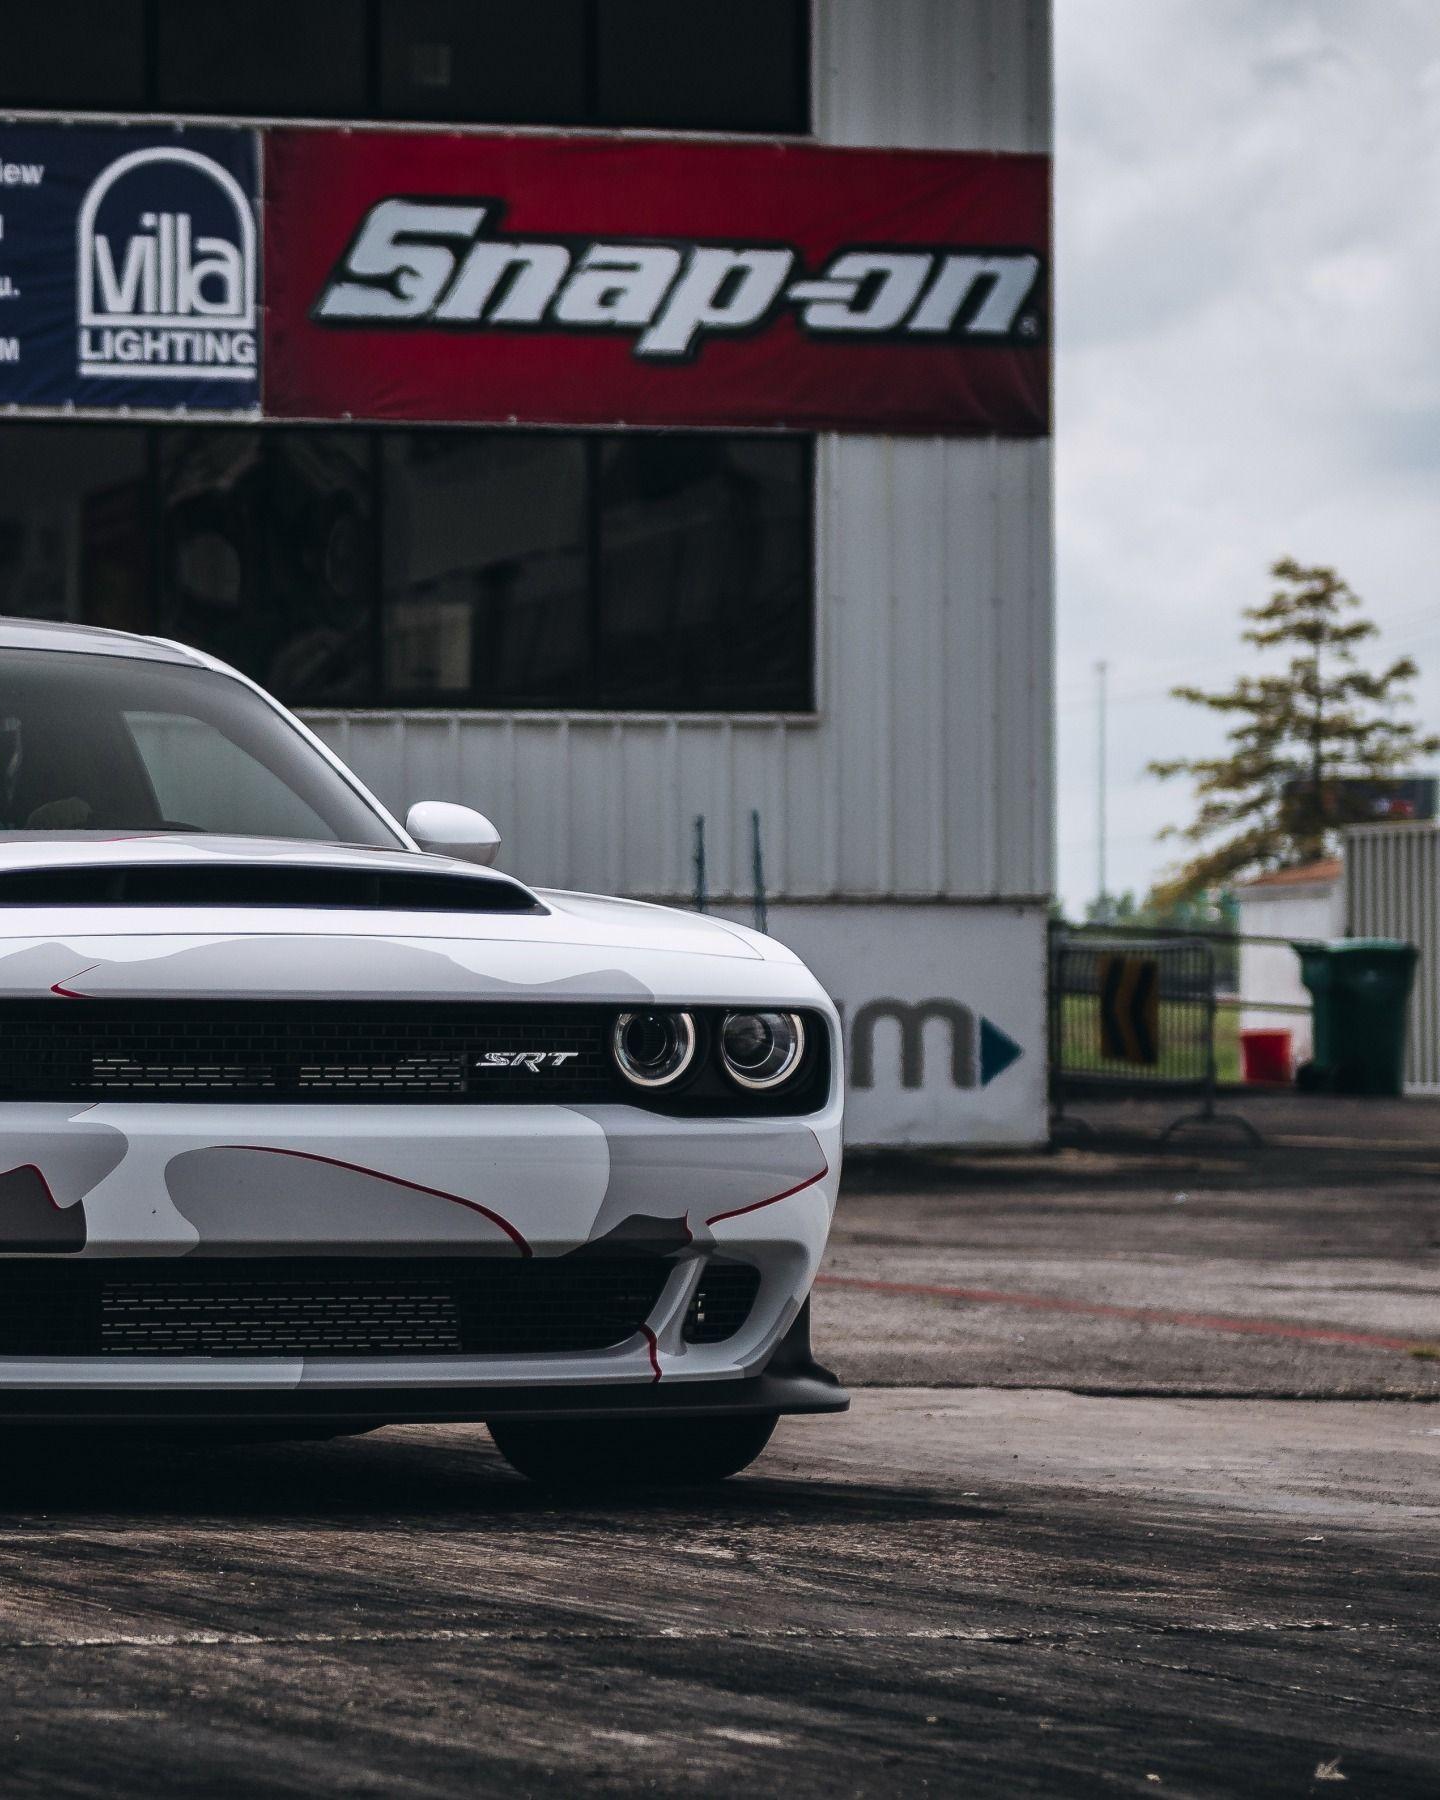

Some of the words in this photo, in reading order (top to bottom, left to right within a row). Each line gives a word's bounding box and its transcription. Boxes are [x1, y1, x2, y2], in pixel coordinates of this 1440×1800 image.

[318, 199, 1041, 356] Snap-on
[79, 329, 258, 364] LIGHTING
[475, 1052, 579, 1073] SRT
